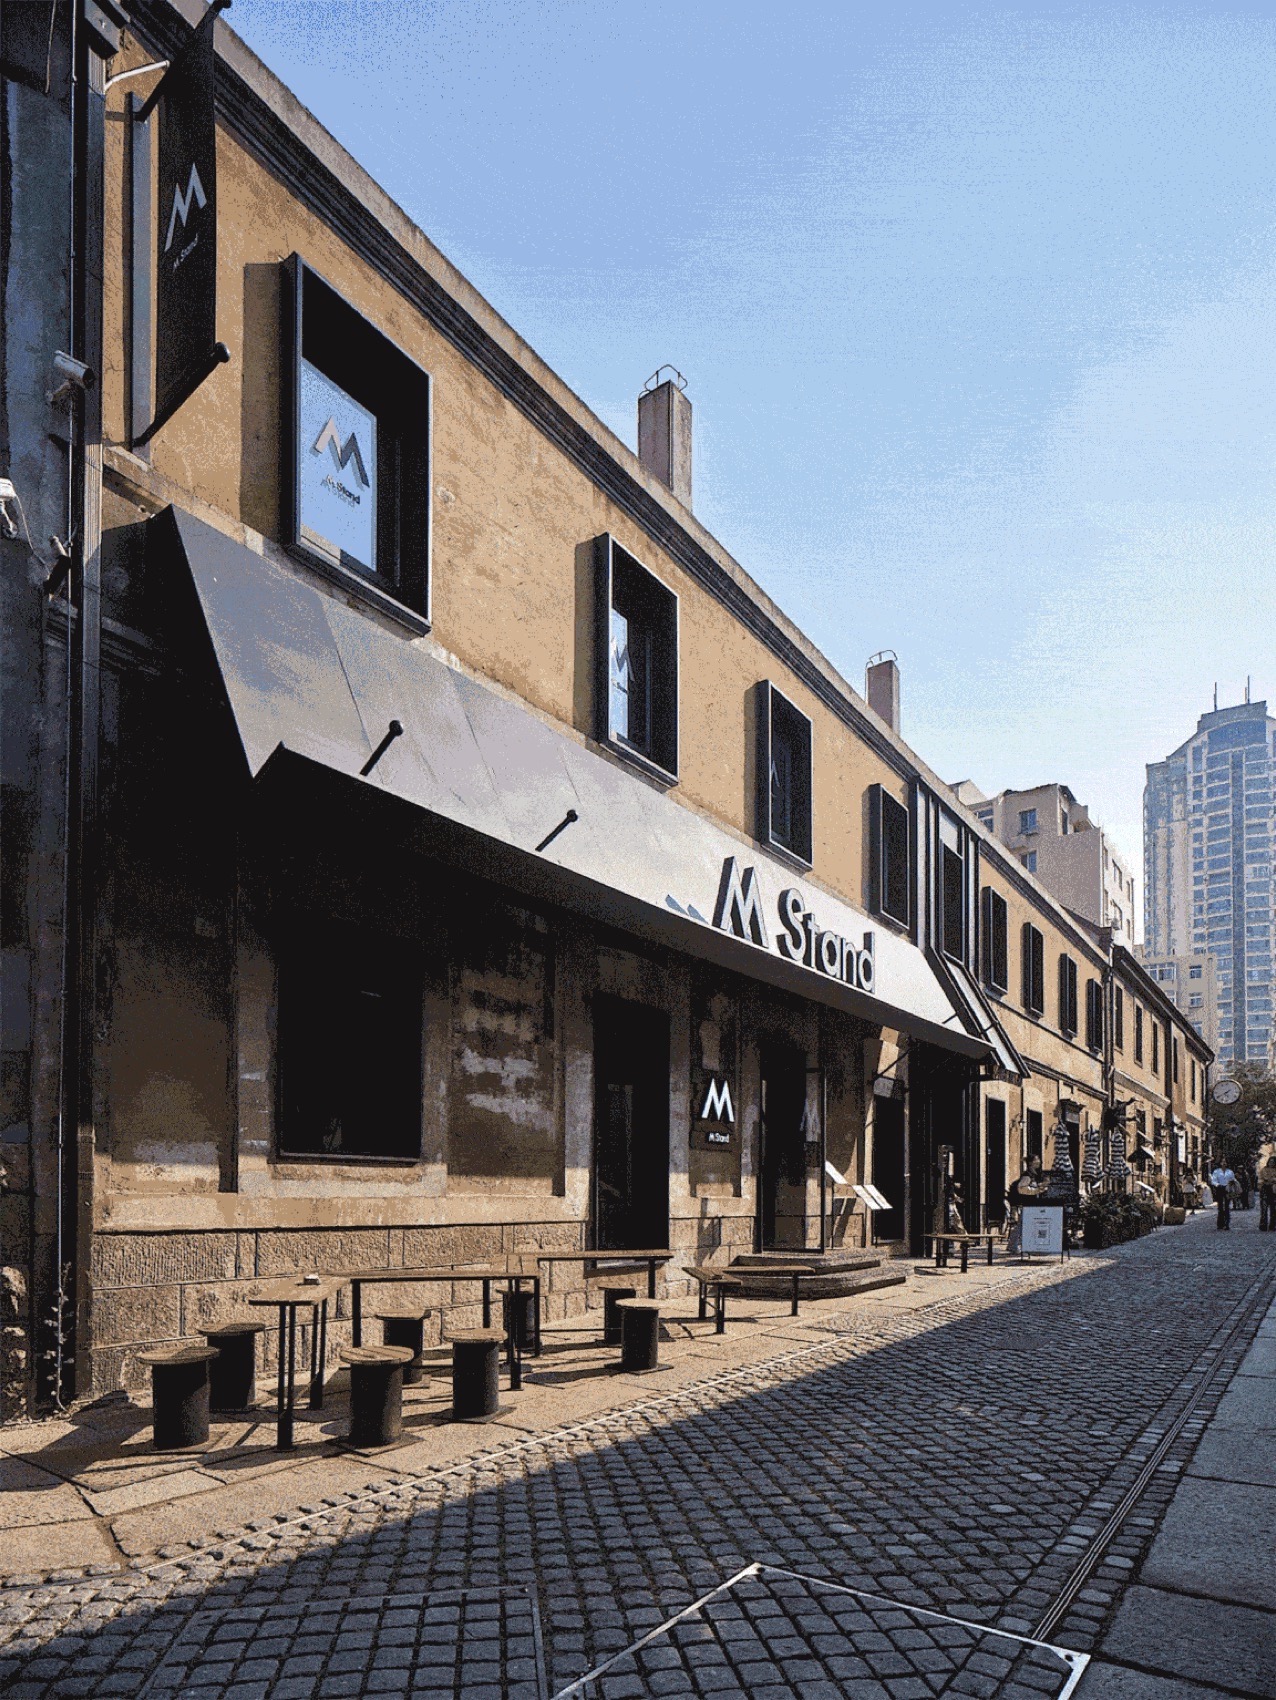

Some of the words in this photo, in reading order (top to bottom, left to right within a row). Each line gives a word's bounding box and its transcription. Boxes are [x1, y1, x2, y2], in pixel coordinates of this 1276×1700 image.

[163, 162, 207, 253] M
[313, 416, 370, 488] M
[711, 855, 769, 949] M
[776, 887, 876, 995] Stand
[701, 1077, 735, 1123] M
